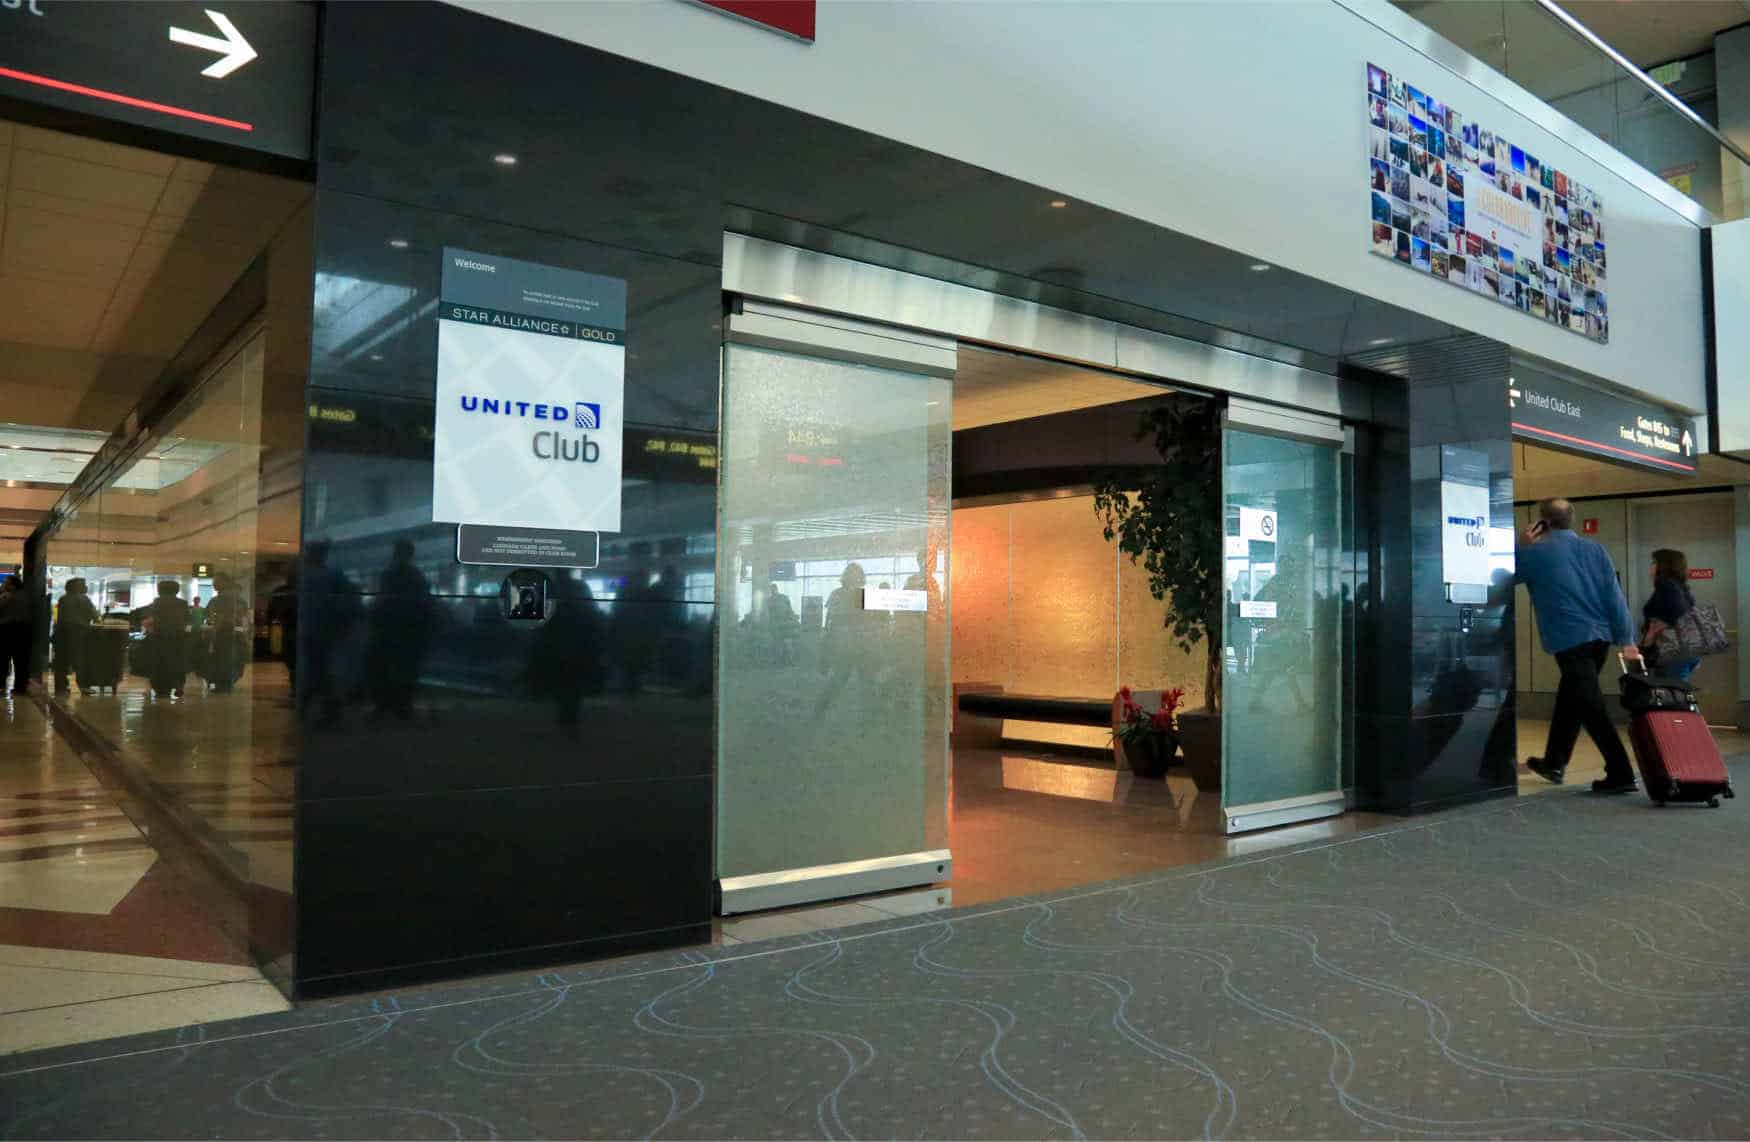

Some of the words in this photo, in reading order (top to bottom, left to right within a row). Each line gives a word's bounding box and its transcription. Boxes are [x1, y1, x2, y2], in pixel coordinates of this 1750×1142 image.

[454, 257, 496, 273] Welcome
[452, 307, 489, 322] STAR
[492, 314, 560, 335] ALLIANCE
[581, 328, 616, 342] GOLD
[461, 395, 569, 421] UNITED
[1525, 388, 1549, 408] United
[1550, 398, 1567, 414] Club
[1567, 402, 1582, 418] East
[532, 431, 600, 463] Club
